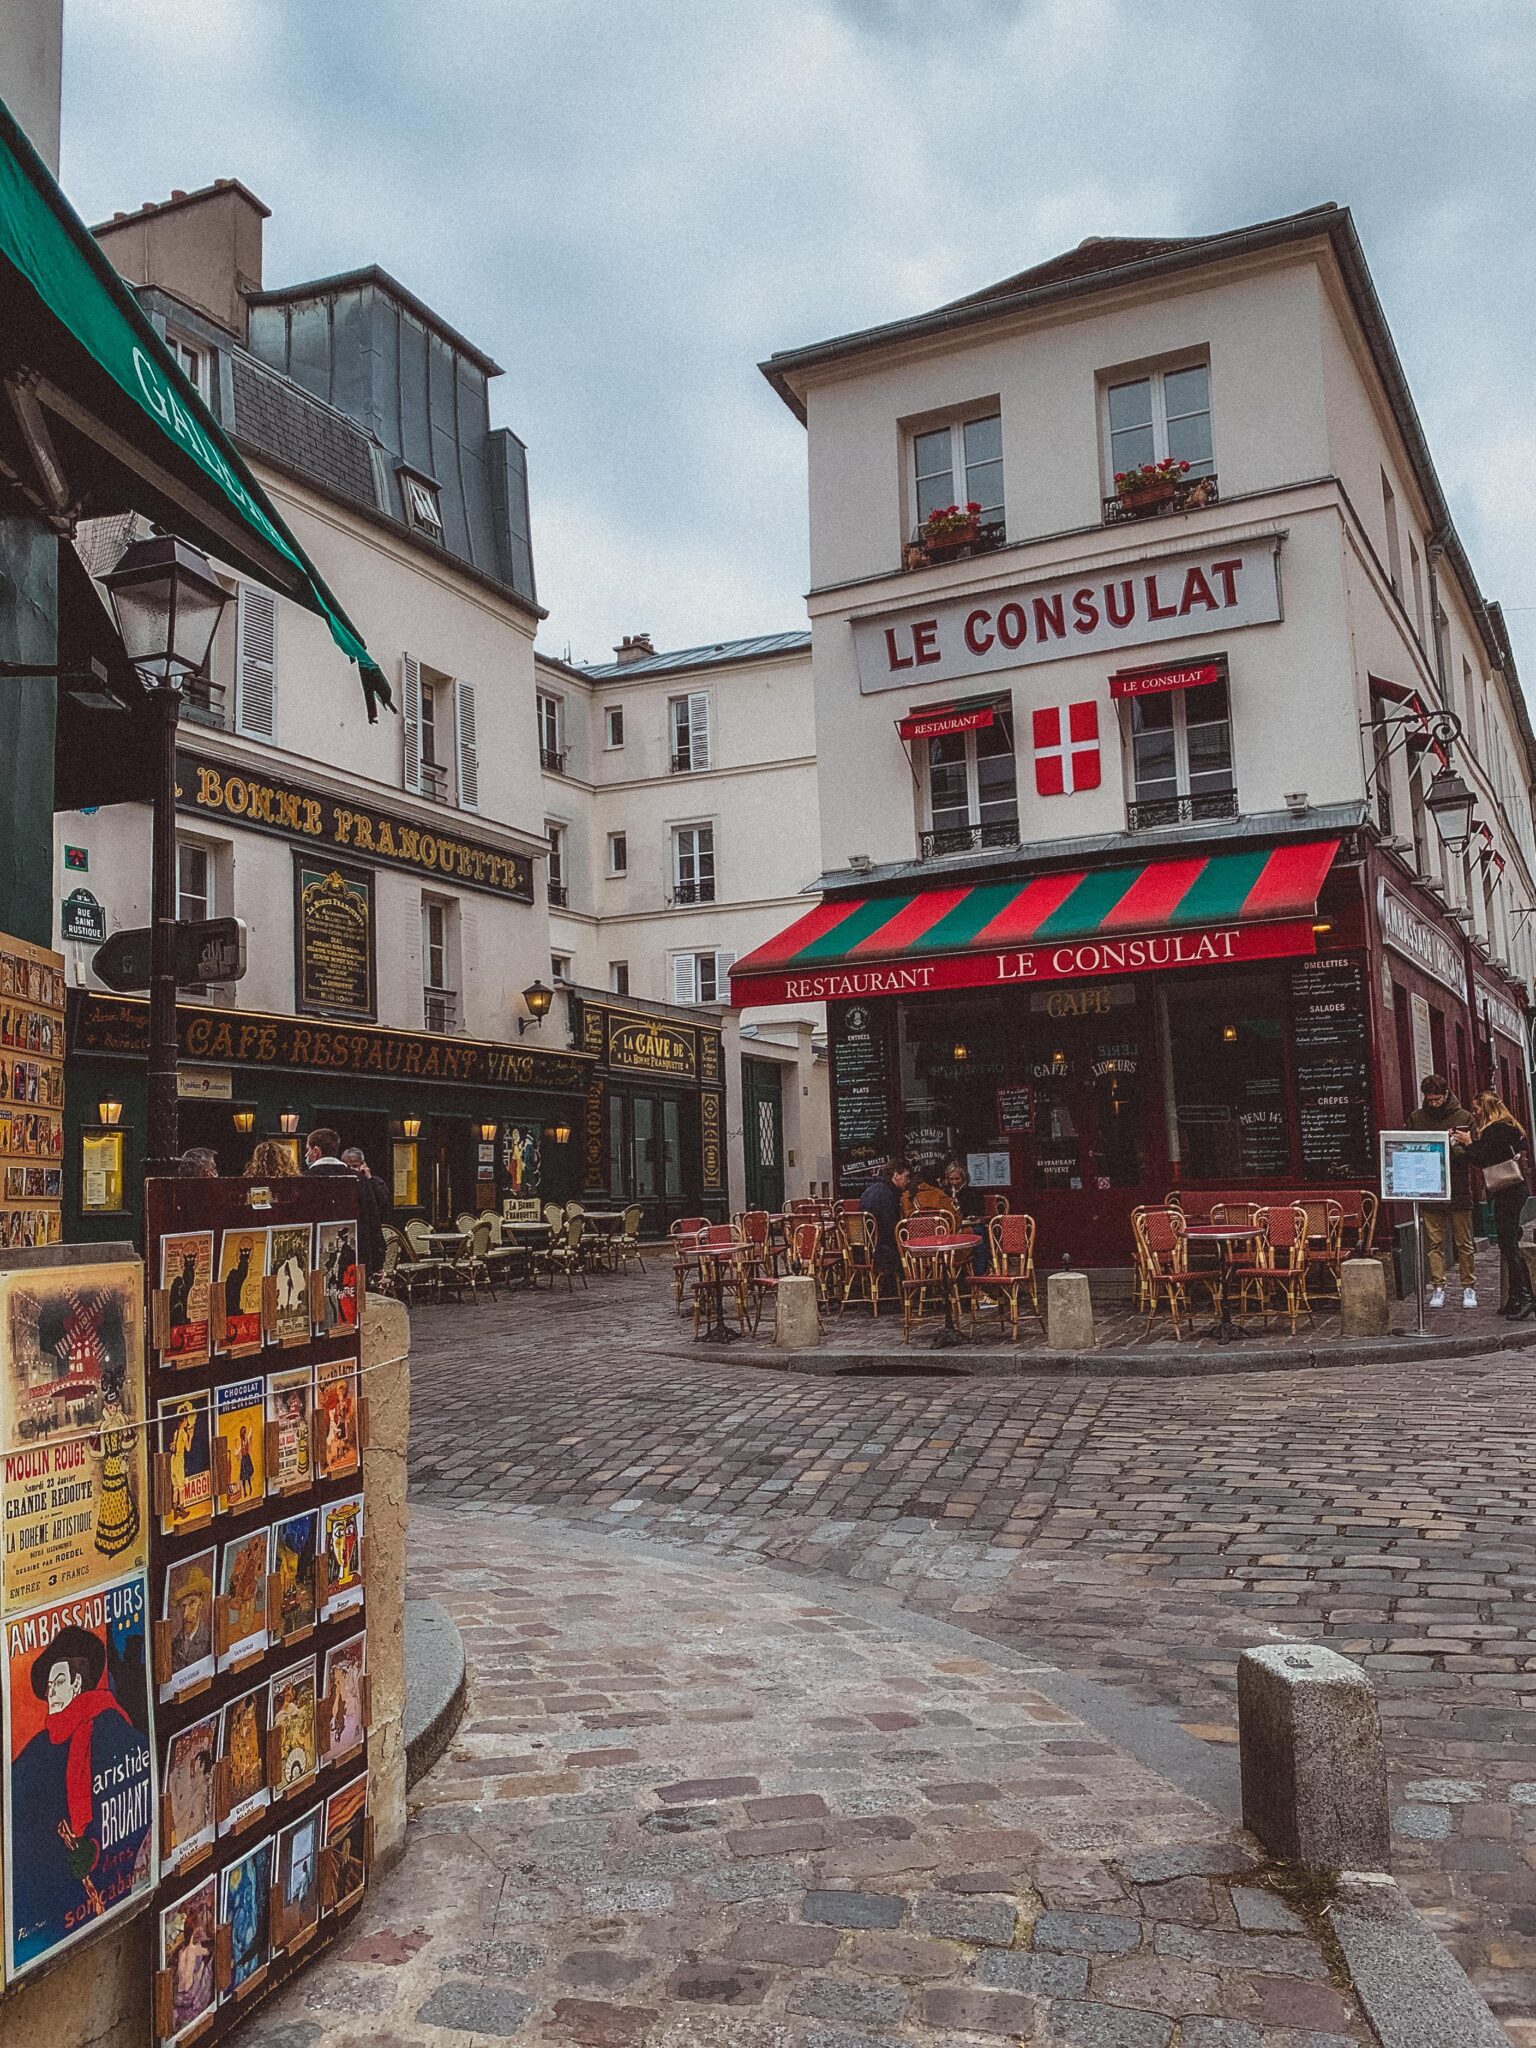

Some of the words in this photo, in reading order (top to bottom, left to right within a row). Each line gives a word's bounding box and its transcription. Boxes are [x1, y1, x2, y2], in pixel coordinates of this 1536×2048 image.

[884, 618, 942, 672] LE
[964, 558, 1244, 656] CONSULAT
[1122, 680, 1139, 693] LE
[1141, 670, 1204, 690] CONSULAT
[914, 714, 979, 735] RESTAURANT
[196, 766, 322, 836] BONNE
[333, 807, 518, 890] FRANQUETTE
[75, 917, 95, 927] SAINT
[77, 908, 92, 917] RUE
[68, 925, 101, 937] RUSTIQUE
[996, 952, 1038, 980] LE
[1052, 930, 1241, 976] CONSULAT
[1304, 959, 1348, 969] OMELETTES
[786, 965, 935, 999] RESTAURANT
[1309, 1003, 1346, 1013] SALADES
[623, 1034, 633, 1050] LA
[635, 1033, 671, 1057] CAVE
[673, 1043, 684, 1057] DE
[290, 1029, 478, 1081] RESTAURANT
[487, 1051, 535, 1085] VINS
[623, 1053, 633, 1064] LA
[1091, 1059, 1137, 1078] LIQUEURS
[1317, 1096, 1349, 1106] CRÊPES
[1239, 1112, 1266, 1125] MENU
[224, 1382, 259, 1398] CHOCOLAT
[5, 1452, 49, 1484] MOULIN
[54, 1442, 86, 1472] ROUGE
[24, 1482, 44, 1494] Samedi
[47, 1478, 55, 1488] 23
[57, 1474, 76, 1486] Janvier
[184, 1475, 210, 1500] MAGGI
[6, 1492, 47, 1520] GRANDE
[51, 1480, 93, 1511] REDOUTE
[6, 1533, 16, 1554] LA
[53, 1510, 93, 1541] ARTISTIQUE
[55, 1548, 84, 1564] ROEDEL
[48, 1574, 57, 1586] 3
[61, 1565, 90, 1582] FRANCS
[10, 1584, 144, 1659] AMBASSADEURS
[93, 1745, 150, 1794] aristide
[101, 1778, 150, 1851] BRUANT
